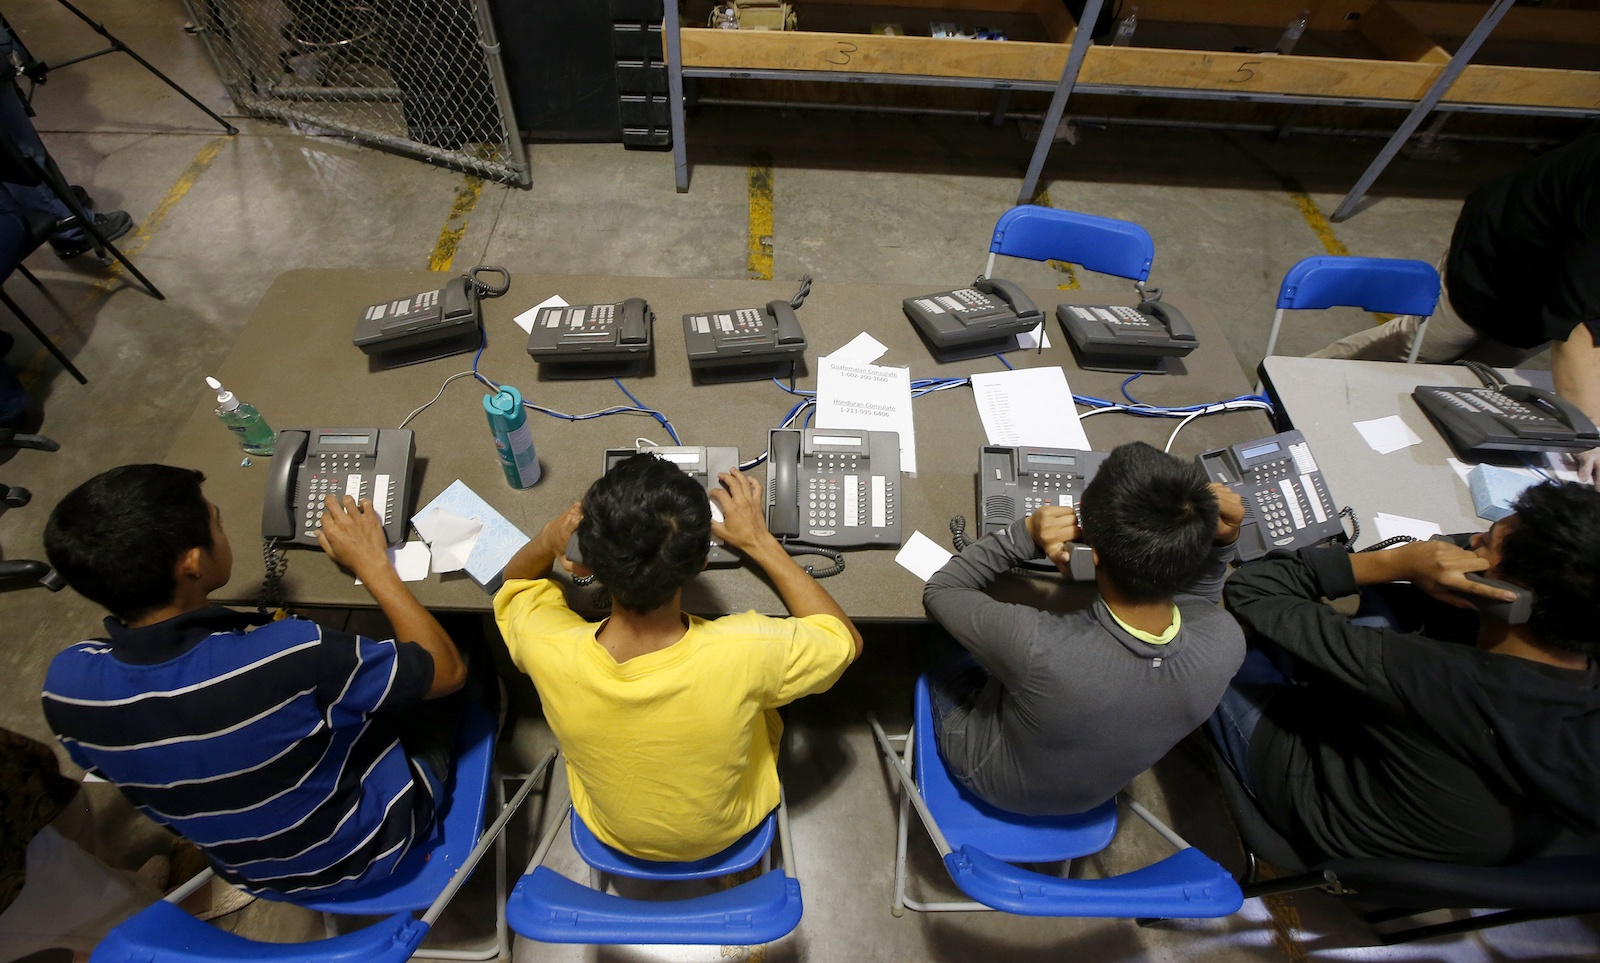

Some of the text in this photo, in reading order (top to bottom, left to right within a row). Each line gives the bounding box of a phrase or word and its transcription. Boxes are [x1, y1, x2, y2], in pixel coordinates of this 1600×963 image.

[826, 41, 859, 65] 3
[1229, 61, 1262, 84] 5
[831, 363, 898, 378] Guatemalan Consulate
[833, 399, 896, 412] Honduran Consulate
